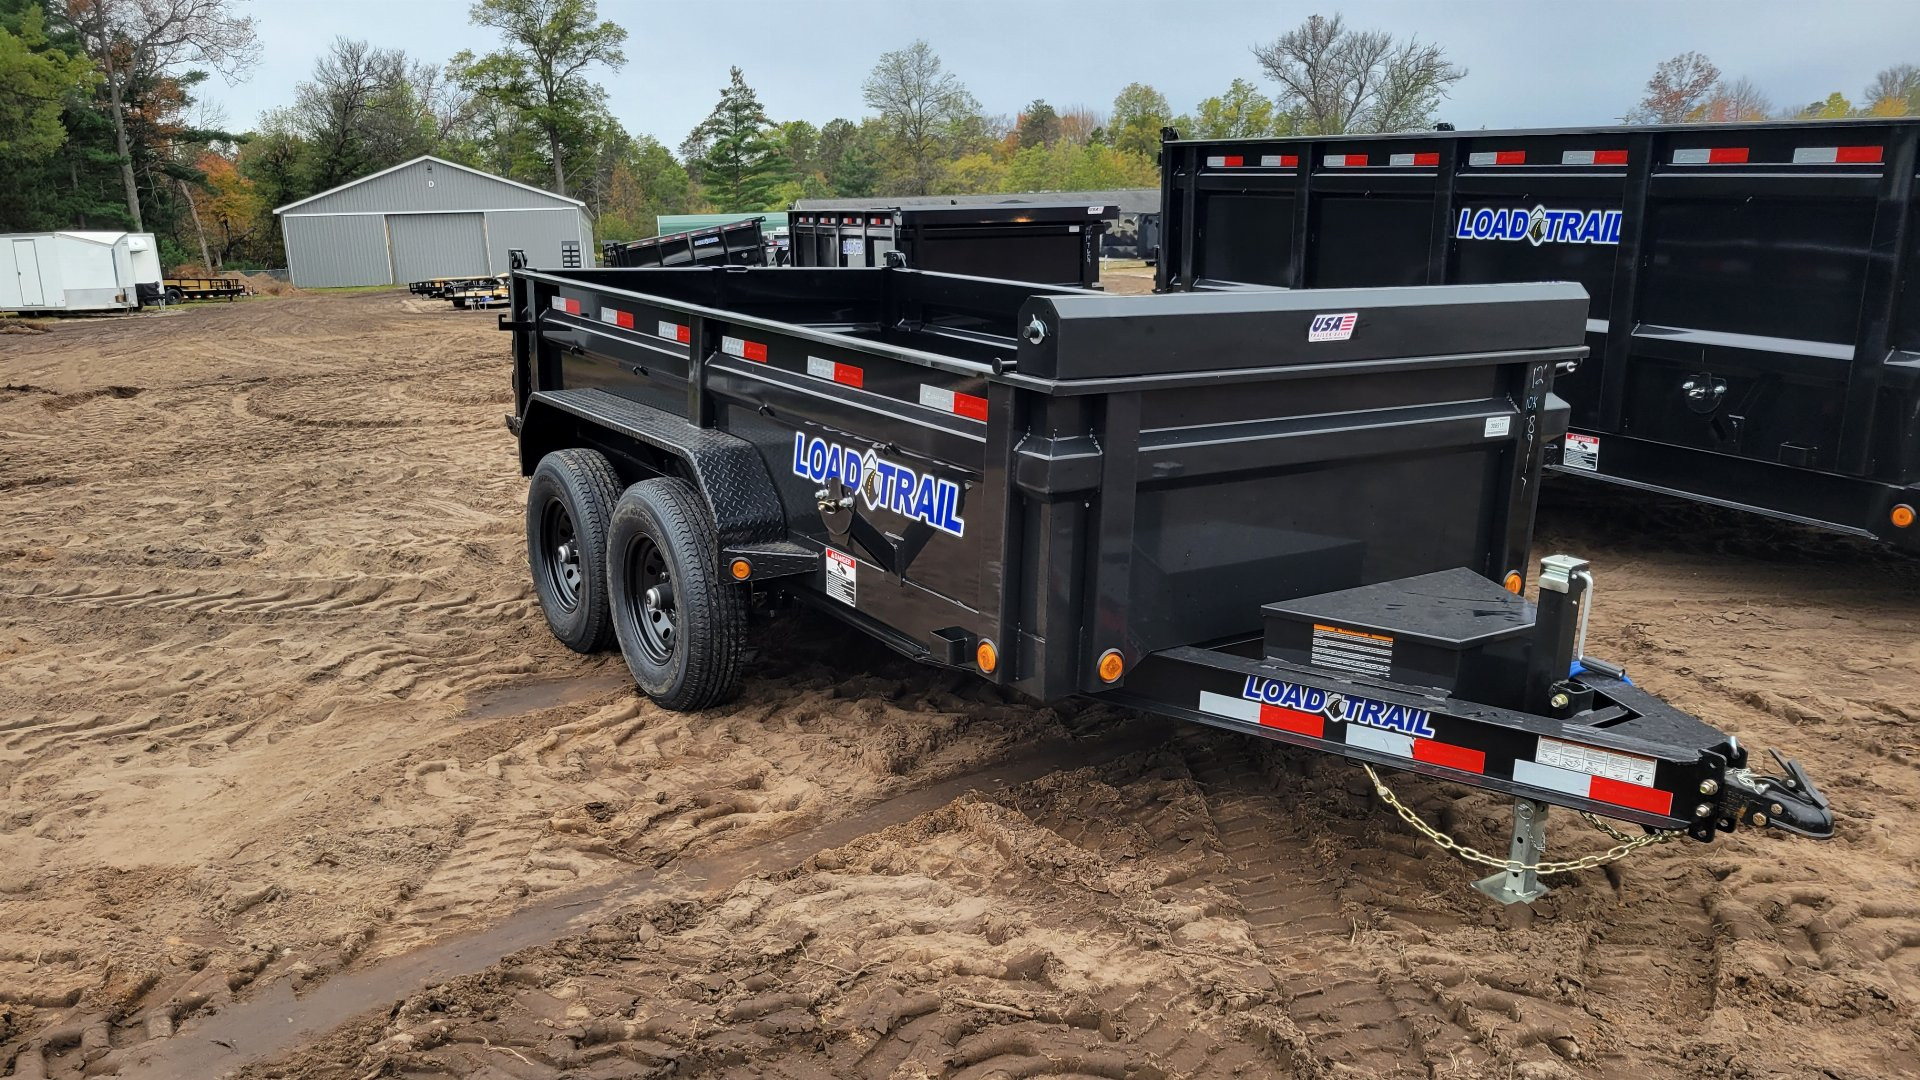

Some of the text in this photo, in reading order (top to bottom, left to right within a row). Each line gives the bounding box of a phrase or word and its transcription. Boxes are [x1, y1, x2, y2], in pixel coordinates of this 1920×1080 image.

[428, 180, 435, 188] D
[1456, 208, 1531, 240] LOAD
[1312, 316, 1344, 332] USA
[793, 431, 964, 537] LOAD TRAIL
[833, 552, 852, 566] DANGER
[1243, 676, 1435, 738] LOAD TRAIL
